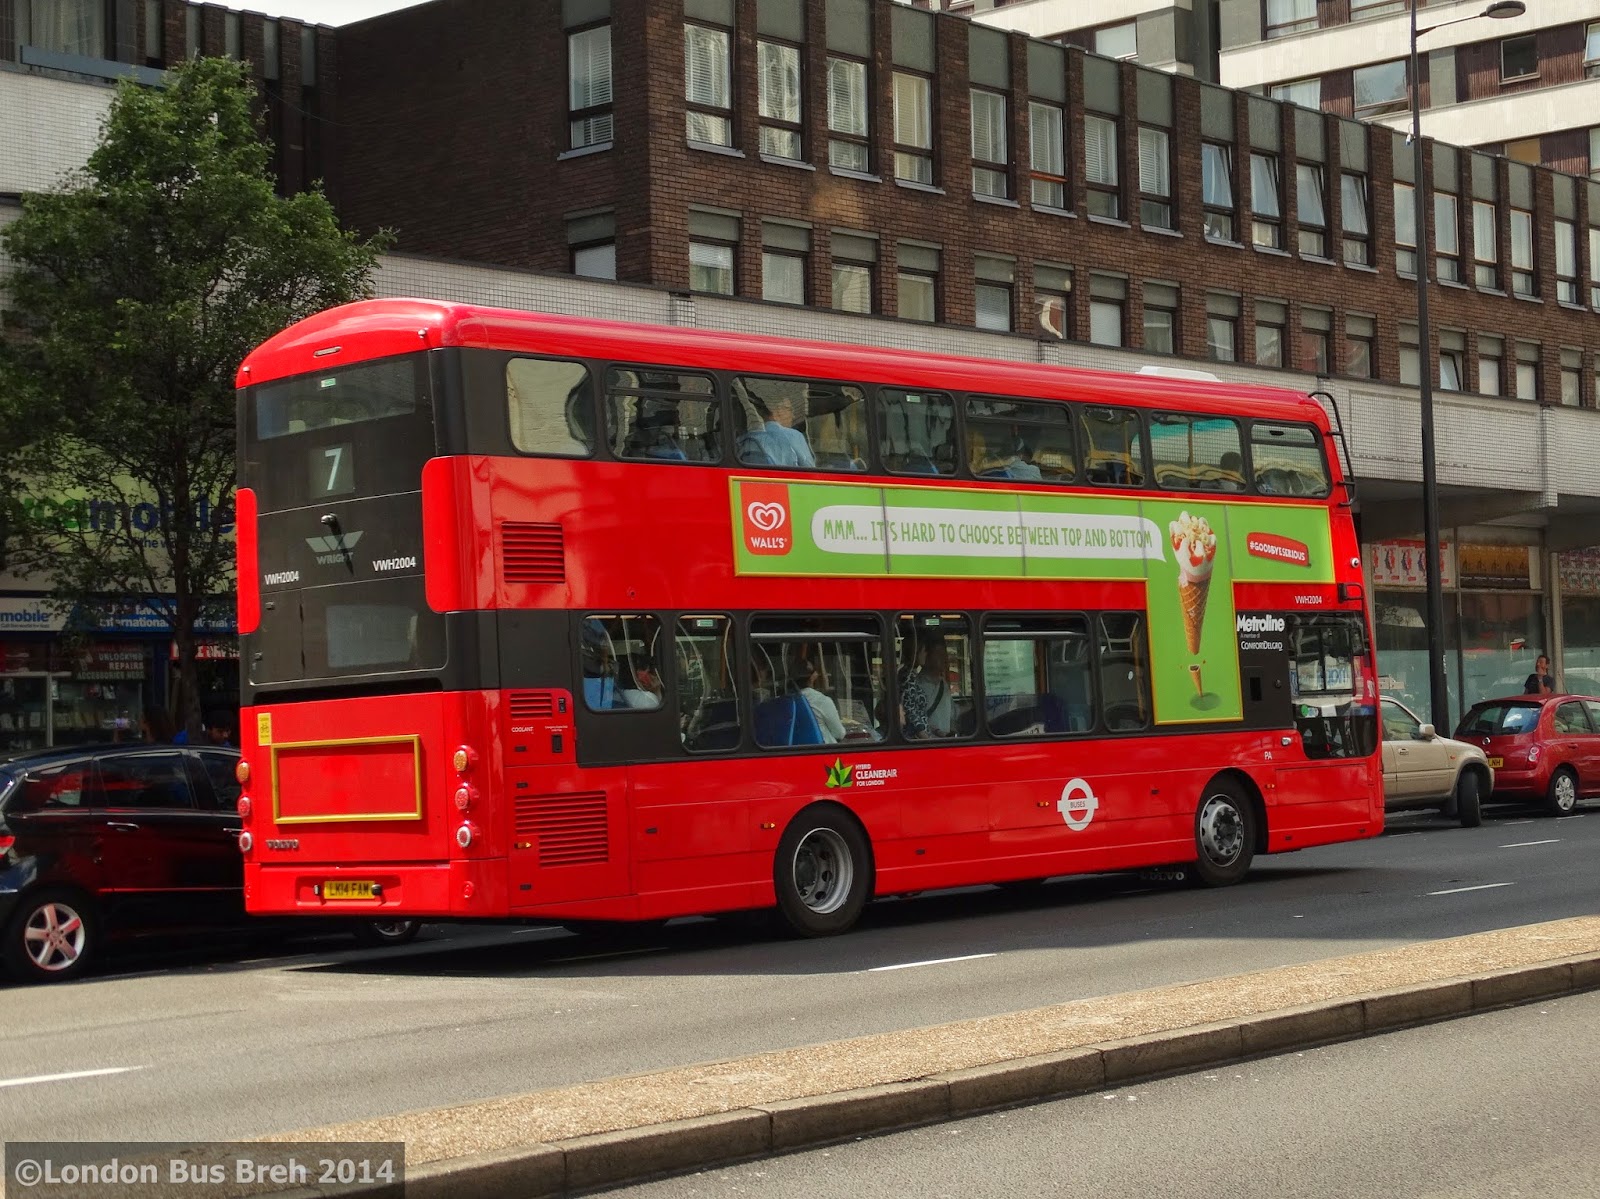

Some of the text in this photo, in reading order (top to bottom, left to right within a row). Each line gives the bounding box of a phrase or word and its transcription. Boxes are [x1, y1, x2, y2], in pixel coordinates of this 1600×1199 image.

[324, 447, 343, 491] 7
[823, 519, 1153, 548] MMM... IT'S HARD TO CHOOSE BETWEEN TOP AND BOTTOM
[750, 536, 785, 549] WALL'S
[1250, 541, 1306, 561] #GOODBYESERIOUS
[372, 557, 416, 572] VWH2004
[264, 570, 300, 586] VWH2004
[1295, 595, 1322, 604] VWH2004
[0, 609, 50, 622] mobile
[1236, 613, 1286, 633] Metroline
[108, 662, 144, 671] REPAIRS
[1264, 750, 1273, 760] PA
[865, 779, 885, 787] LONDON
[1069, 801, 1086, 809] BUSES
[328, 881, 350, 897] LK14
